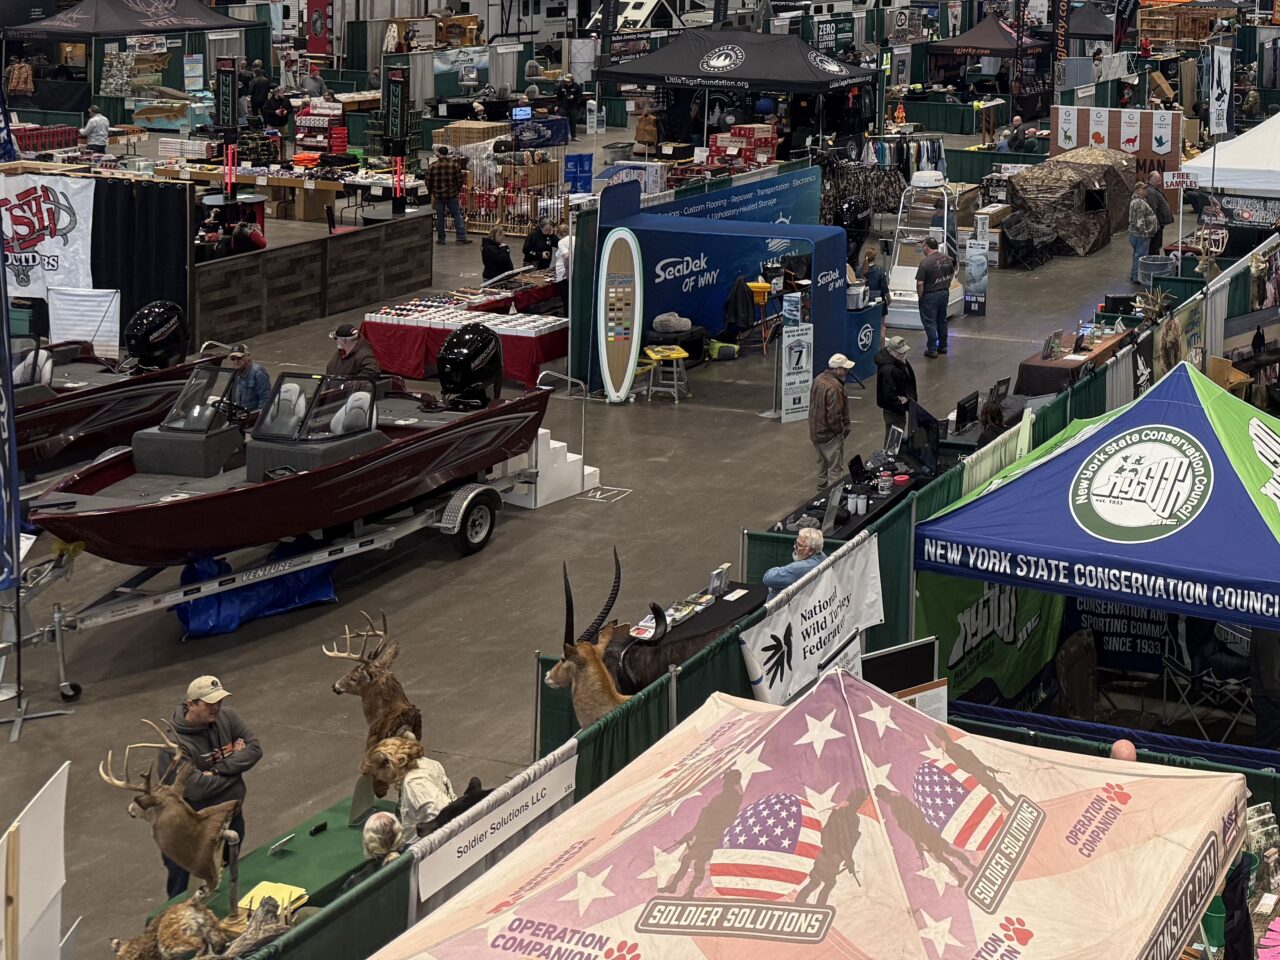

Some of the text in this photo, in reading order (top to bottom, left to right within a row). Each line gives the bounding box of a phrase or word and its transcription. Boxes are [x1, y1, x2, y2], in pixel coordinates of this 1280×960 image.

[818, 23, 836, 35] ZERO
[665, 76, 749, 88] LittleTagsFoundation.org
[221, 73, 231, 126] UNCUT
[391, 83, 400, 138] UNCUT
[1165, 180, 1198, 189] SAMPLES
[1172, 172, 1191, 180] FREE
[683, 203, 705, 215] Custom
[705, 198, 727, 212] Flooring
[730, 192, 753, 204] Repower
[756, 182, 790, 197] Transportation
[792, 174, 816, 188] Electronics
[755, 197, 777, 212] Storage
[654, 252, 709, 284] SeaDek
[682, 269, 720, 293] OF WNY
[817, 268, 840, 286] SeaDek
[828, 277, 845, 291] OF WNY
[149, 316, 179, 343] MERCURY
[470, 340, 497, 371] MERCURY
[793, 349, 803, 366] 7
[1075, 430, 1208, 521] New York State Conservation Council
[240, 561, 295, 582] VENTURE
[923, 537, 962, 565] NEW
[966, 544, 1012, 575] YORK
[1015, 553, 1069, 584] STATE
[1073, 563, 1207, 606] CONSERVATION
[800, 585, 838, 626] National
[1076, 597, 1148, 620] CONSERVATION
[800, 619, 828, 643] Wild
[1081, 613, 1128, 634] SPORTING
[1103, 636, 1132, 652] SINCE
[456, 787, 547, 859] Soldier Solutions LLC
[1065, 794, 1108, 846] OPERATION
[1078, 804, 1123, 859] COMPANION
[973, 852, 1013, 905] SOLDIER
[1000, 802, 1039, 859] SOLUTIONS
[647, 904, 824, 935] SOLDIER SOLUTIONS
[490, 933, 600, 960] COMPANION
[507, 916, 611, 952] OPERATION
